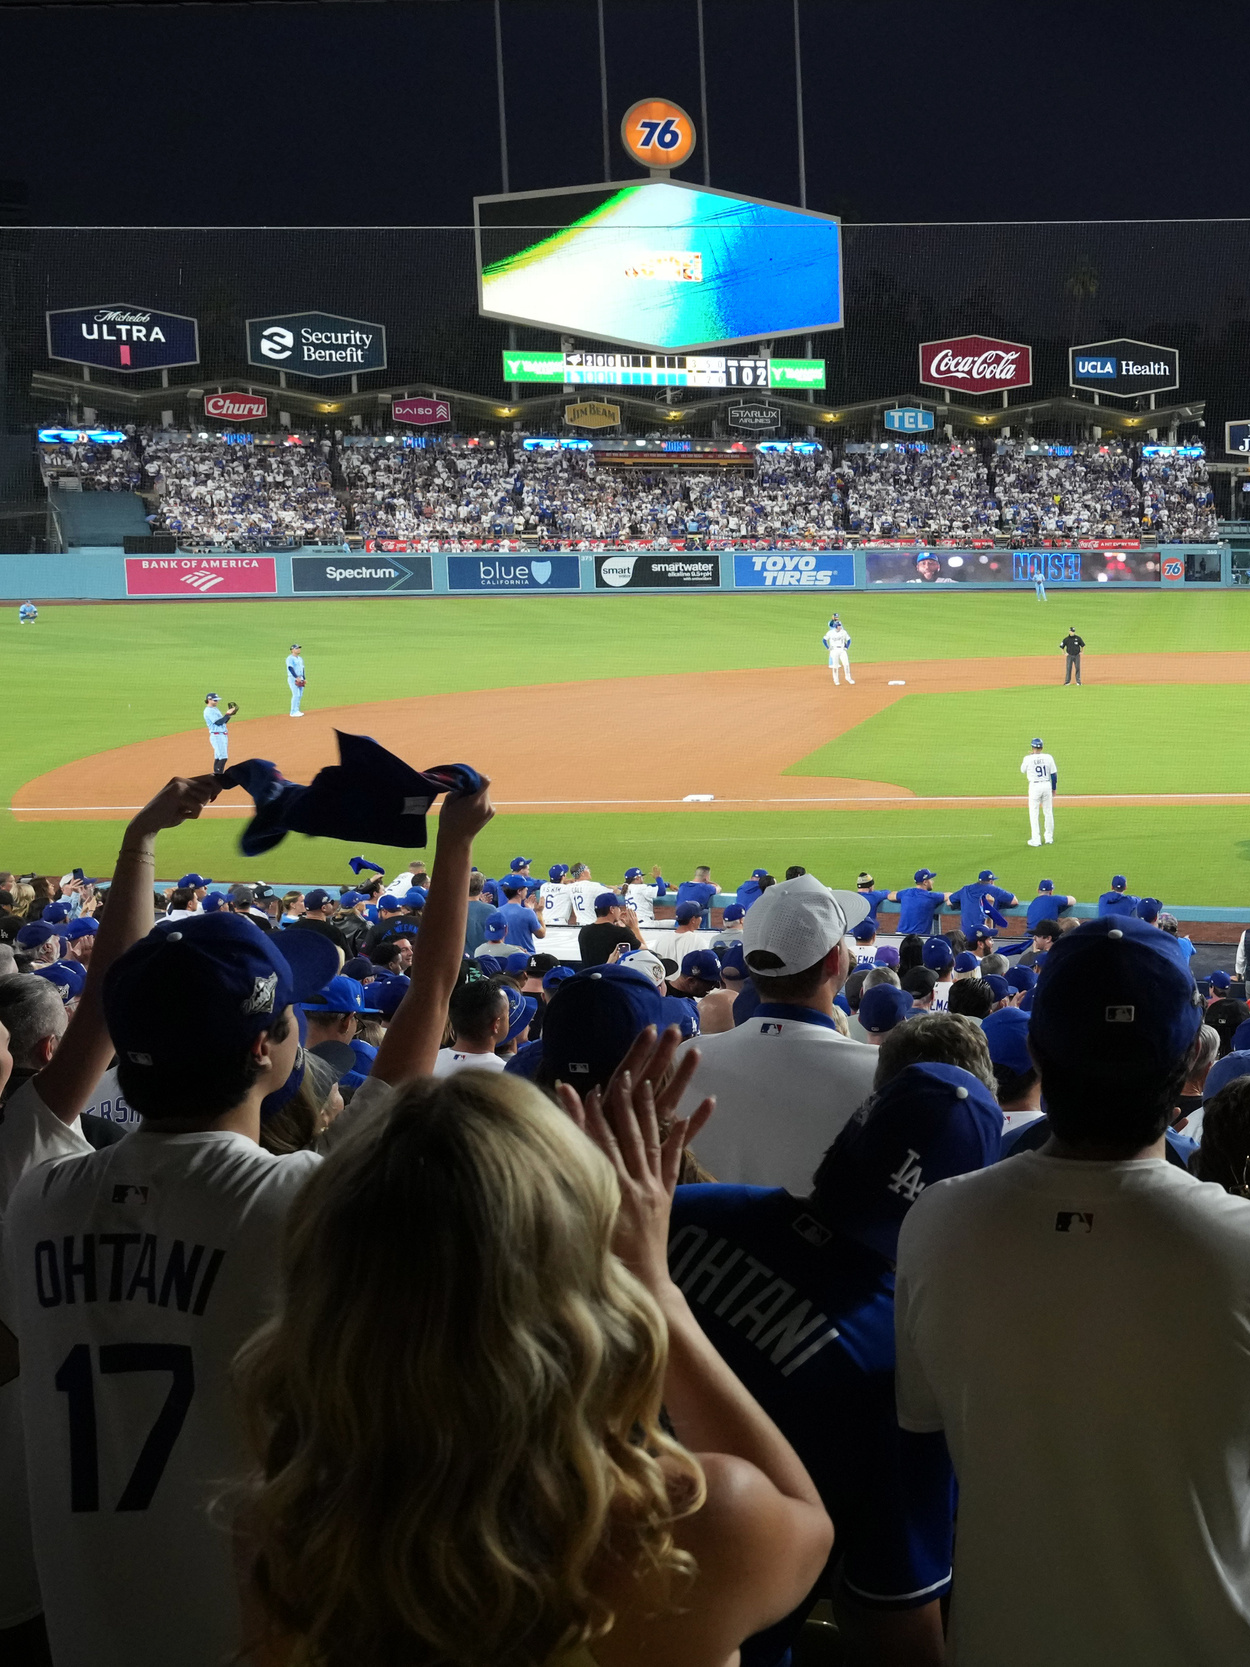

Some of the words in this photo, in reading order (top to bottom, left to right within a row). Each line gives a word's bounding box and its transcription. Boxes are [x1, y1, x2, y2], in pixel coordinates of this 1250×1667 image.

[636, 117, 682, 150] 76
[94, 310, 151, 323] Michelob
[81, 323, 166, 343] ULTRA
[301, 328, 373, 349] Security
[303, 346, 364, 362] Benefit
[586, 355, 593, 367] 2
[622, 356, 628, 367] 1
[930, 349, 1020, 380] Coca-Cola
[1078, 361, 1113, 373] UCLA
[1121, 361, 1170, 376] Health
[729, 367, 737, 385] 1
[742, 367, 753, 385] 0
[756, 367, 767, 385] 2
[207, 398, 265, 415] Churu
[395, 407, 432, 415] DAISO
[570, 409, 588, 423] JIM
[589, 404, 616, 422] BEAM
[731, 410, 777, 419] STARLUX
[890, 412, 928, 429] TEL
[142, 560, 178, 569] BANK
[181, 560, 198, 568] OF
[201, 559, 259, 568] AMERICA
[480, 562, 529, 579] blue
[602, 567, 631, 575] smart
[651, 562, 714, 571] smartwater
[752, 556, 817, 571] TOYO
[1013, 553, 1081, 581] NOISE!
[1165, 562, 1181, 575] 76
[326, 566, 395, 581] Spectrum
[763, 571, 832, 586] TIRES
[1035, 765, 1047, 777] 91
[545, 894, 554, 910] 6
[573, 895, 586, 911] 12
[394, 923, 419, 934] WEEKN
[530, 957, 537, 967] LA
[887, 1149, 925, 1200] LA
[34, 1233, 227, 1316] OHTANI
[667, 1224, 840, 1377] OHTANI
[55, 1343, 195, 1513] 17
